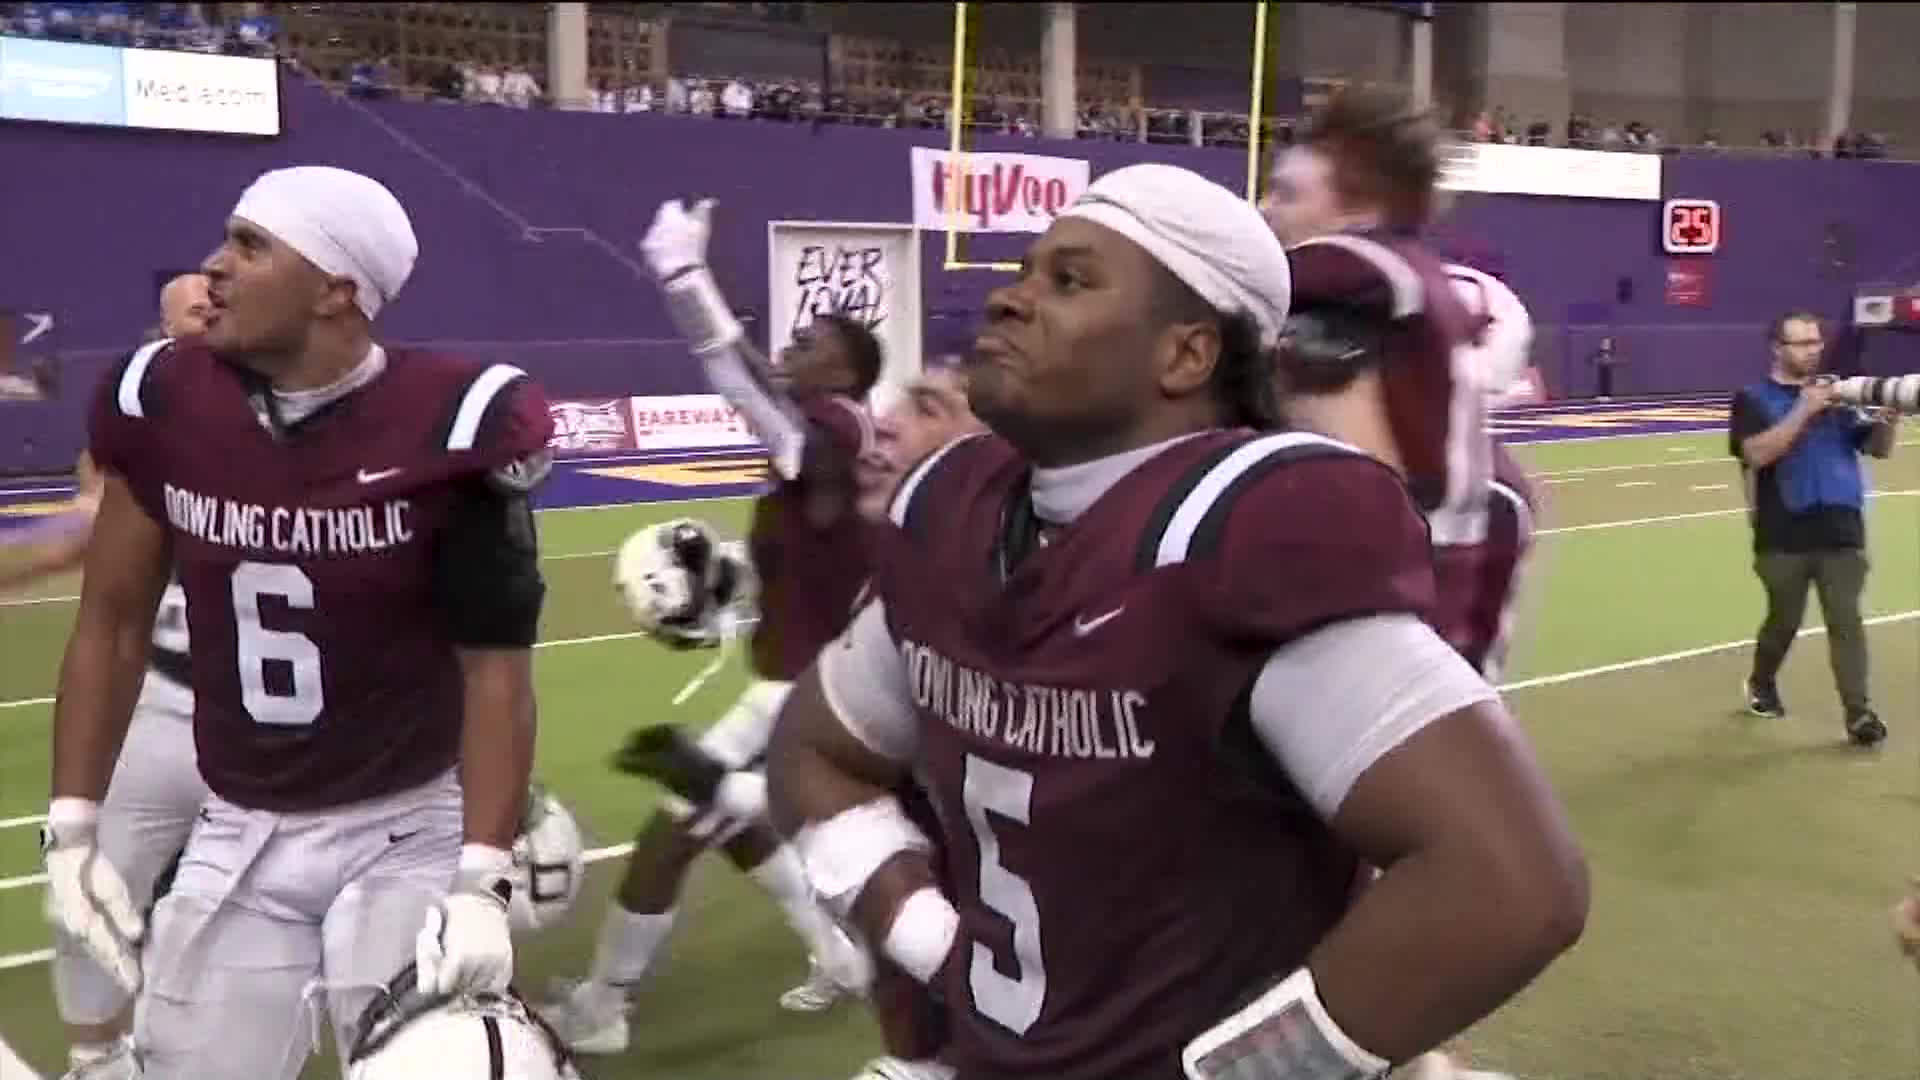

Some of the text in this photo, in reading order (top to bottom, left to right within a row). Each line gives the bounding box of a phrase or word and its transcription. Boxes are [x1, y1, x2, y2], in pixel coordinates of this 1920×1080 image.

[1671, 207, 1712, 244] 25
[798, 245, 883, 288] EVER
[638, 407, 738, 425] FAREWAY
[163, 482, 414, 553] DOWLING CATHOLIC
[231, 560, 325, 724] 6
[1002, 682, 1155, 759] CATHOLIC
[963, 752, 1048, 1036] 5
